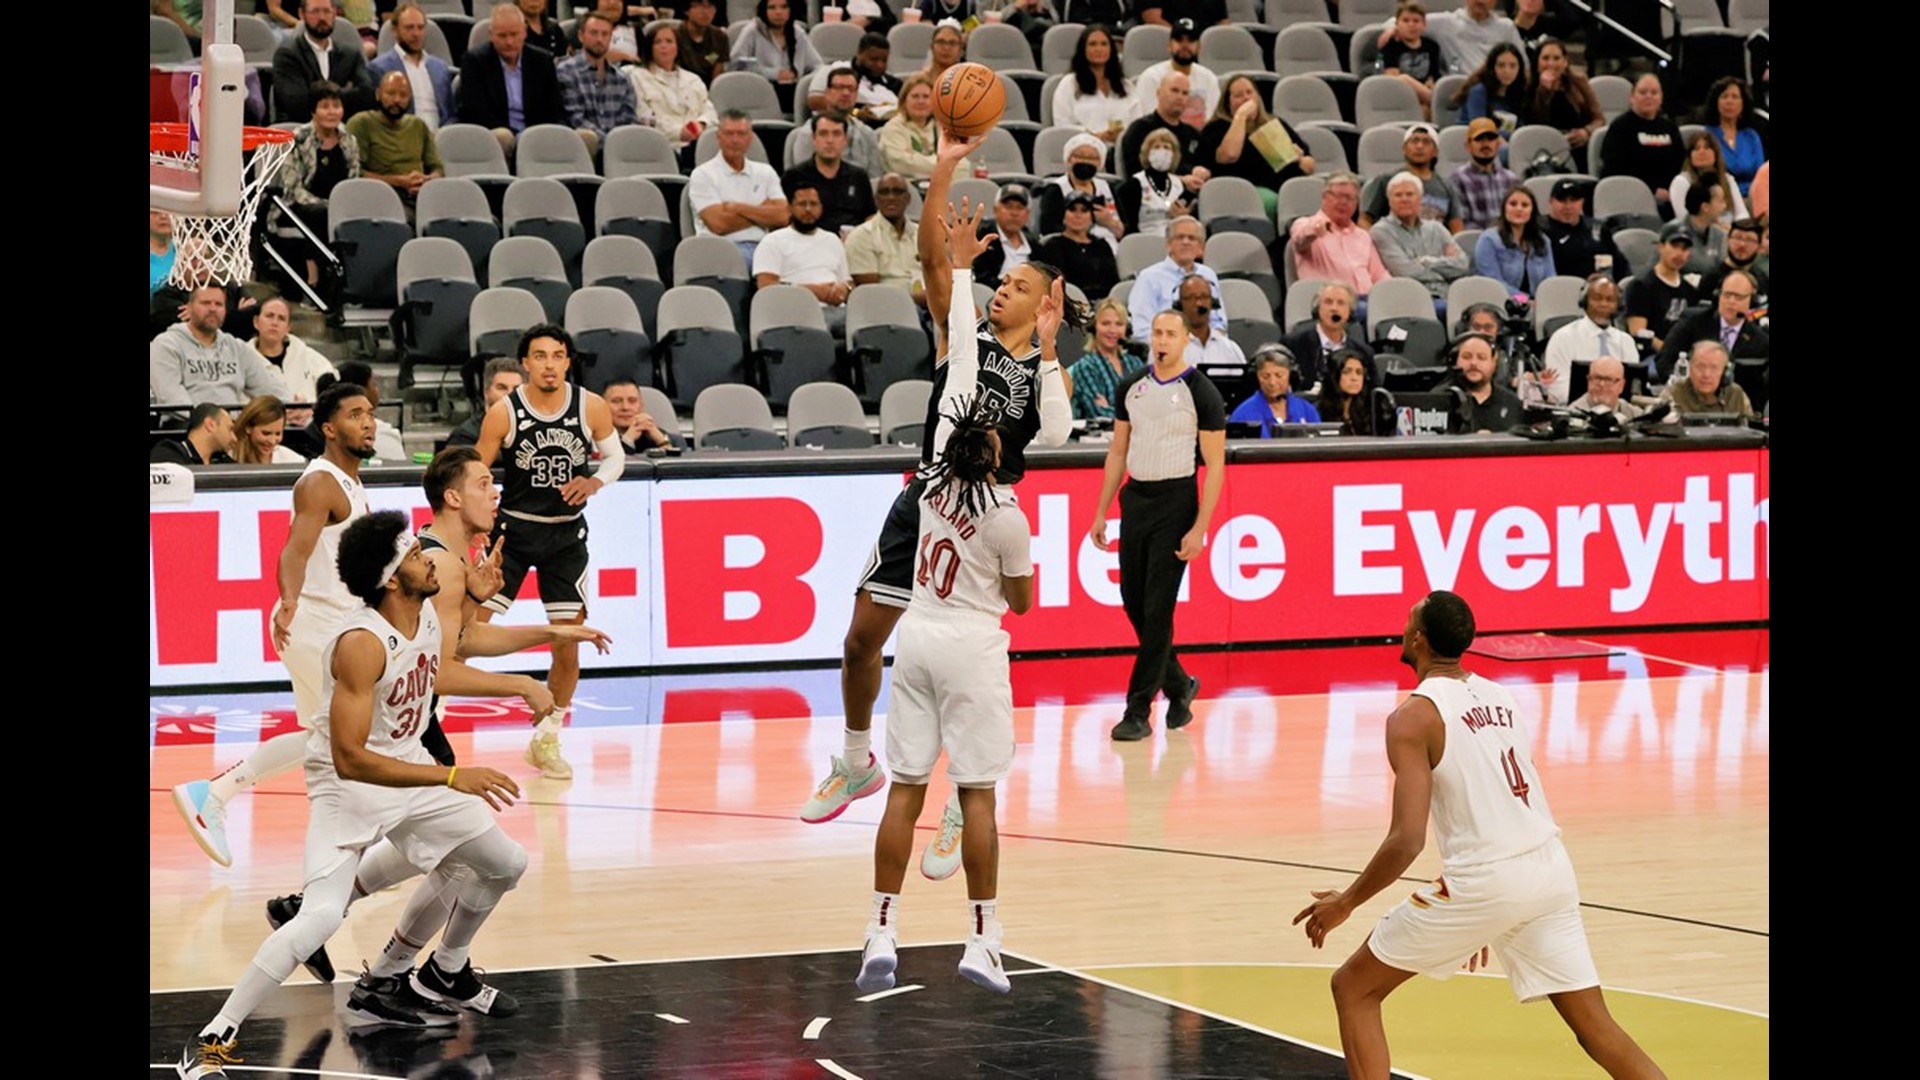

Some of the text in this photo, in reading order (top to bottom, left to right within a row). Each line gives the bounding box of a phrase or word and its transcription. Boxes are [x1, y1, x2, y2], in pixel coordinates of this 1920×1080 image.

[983, 351, 1030, 419] ANTONIO
[515, 428, 586, 470] SAN ANTONIO
[531, 454, 572, 489] 33
[927, 491, 976, 541] RLAND
[917, 532, 961, 600] 10
[1030, 492, 1287, 608] Hee
[387, 652, 438, 707] CAVS
[391, 703, 423, 739] 31
[1500, 746, 1531, 810] 4
